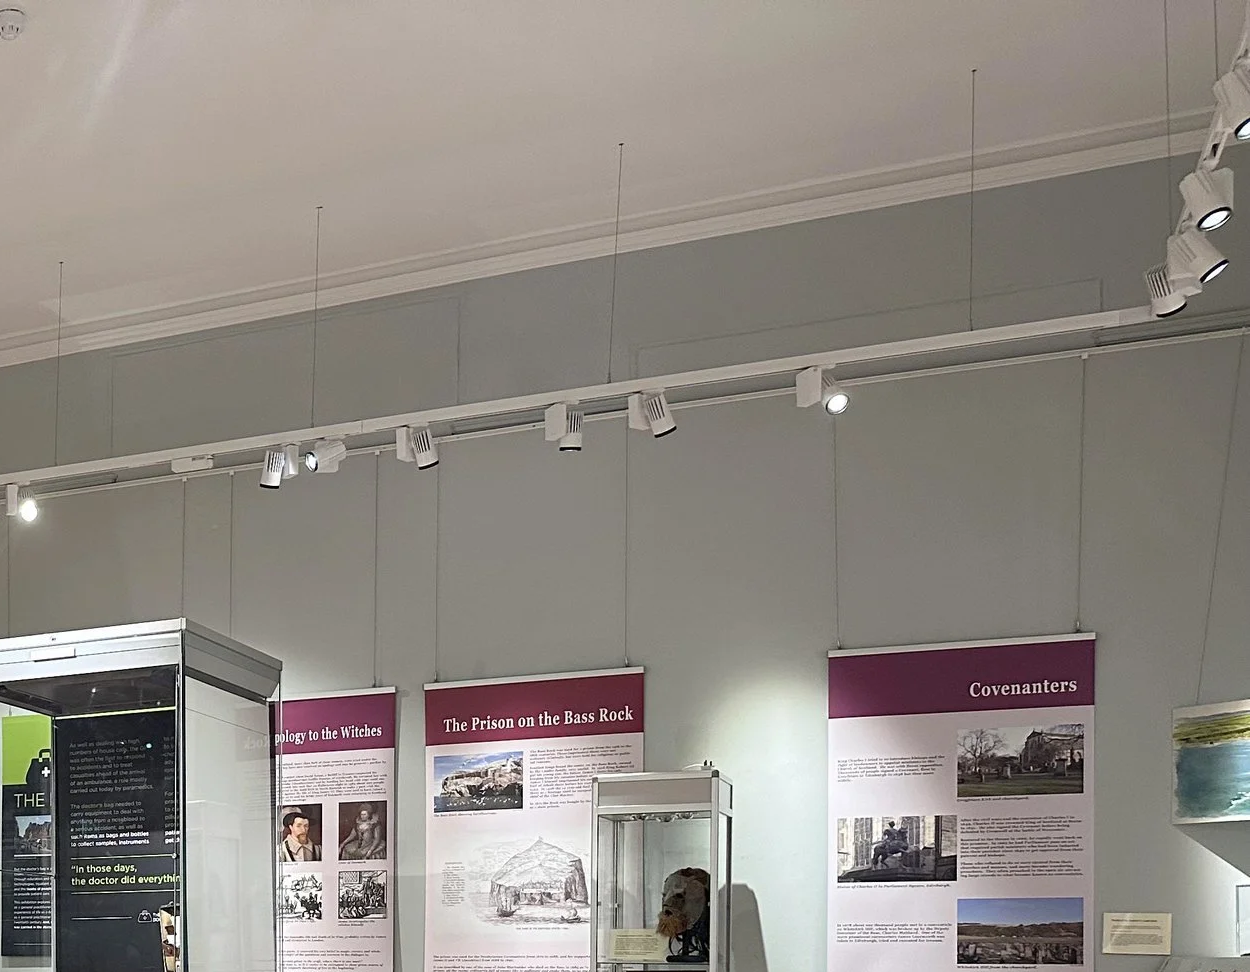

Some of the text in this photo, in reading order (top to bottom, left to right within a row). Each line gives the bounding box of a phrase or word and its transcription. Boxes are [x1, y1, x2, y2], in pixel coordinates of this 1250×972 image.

[969, 679, 1077, 698] Covenanters
[444, 706, 634, 732] The Prison on the Bass Rock
[275, 724, 382, 746] pology to the Witches
[14, 792, 45, 808] THE
[87, 865, 112, 873] those
[114, 864, 138, 872] days,
[71, 873, 180, 885] the doctor did everythin
